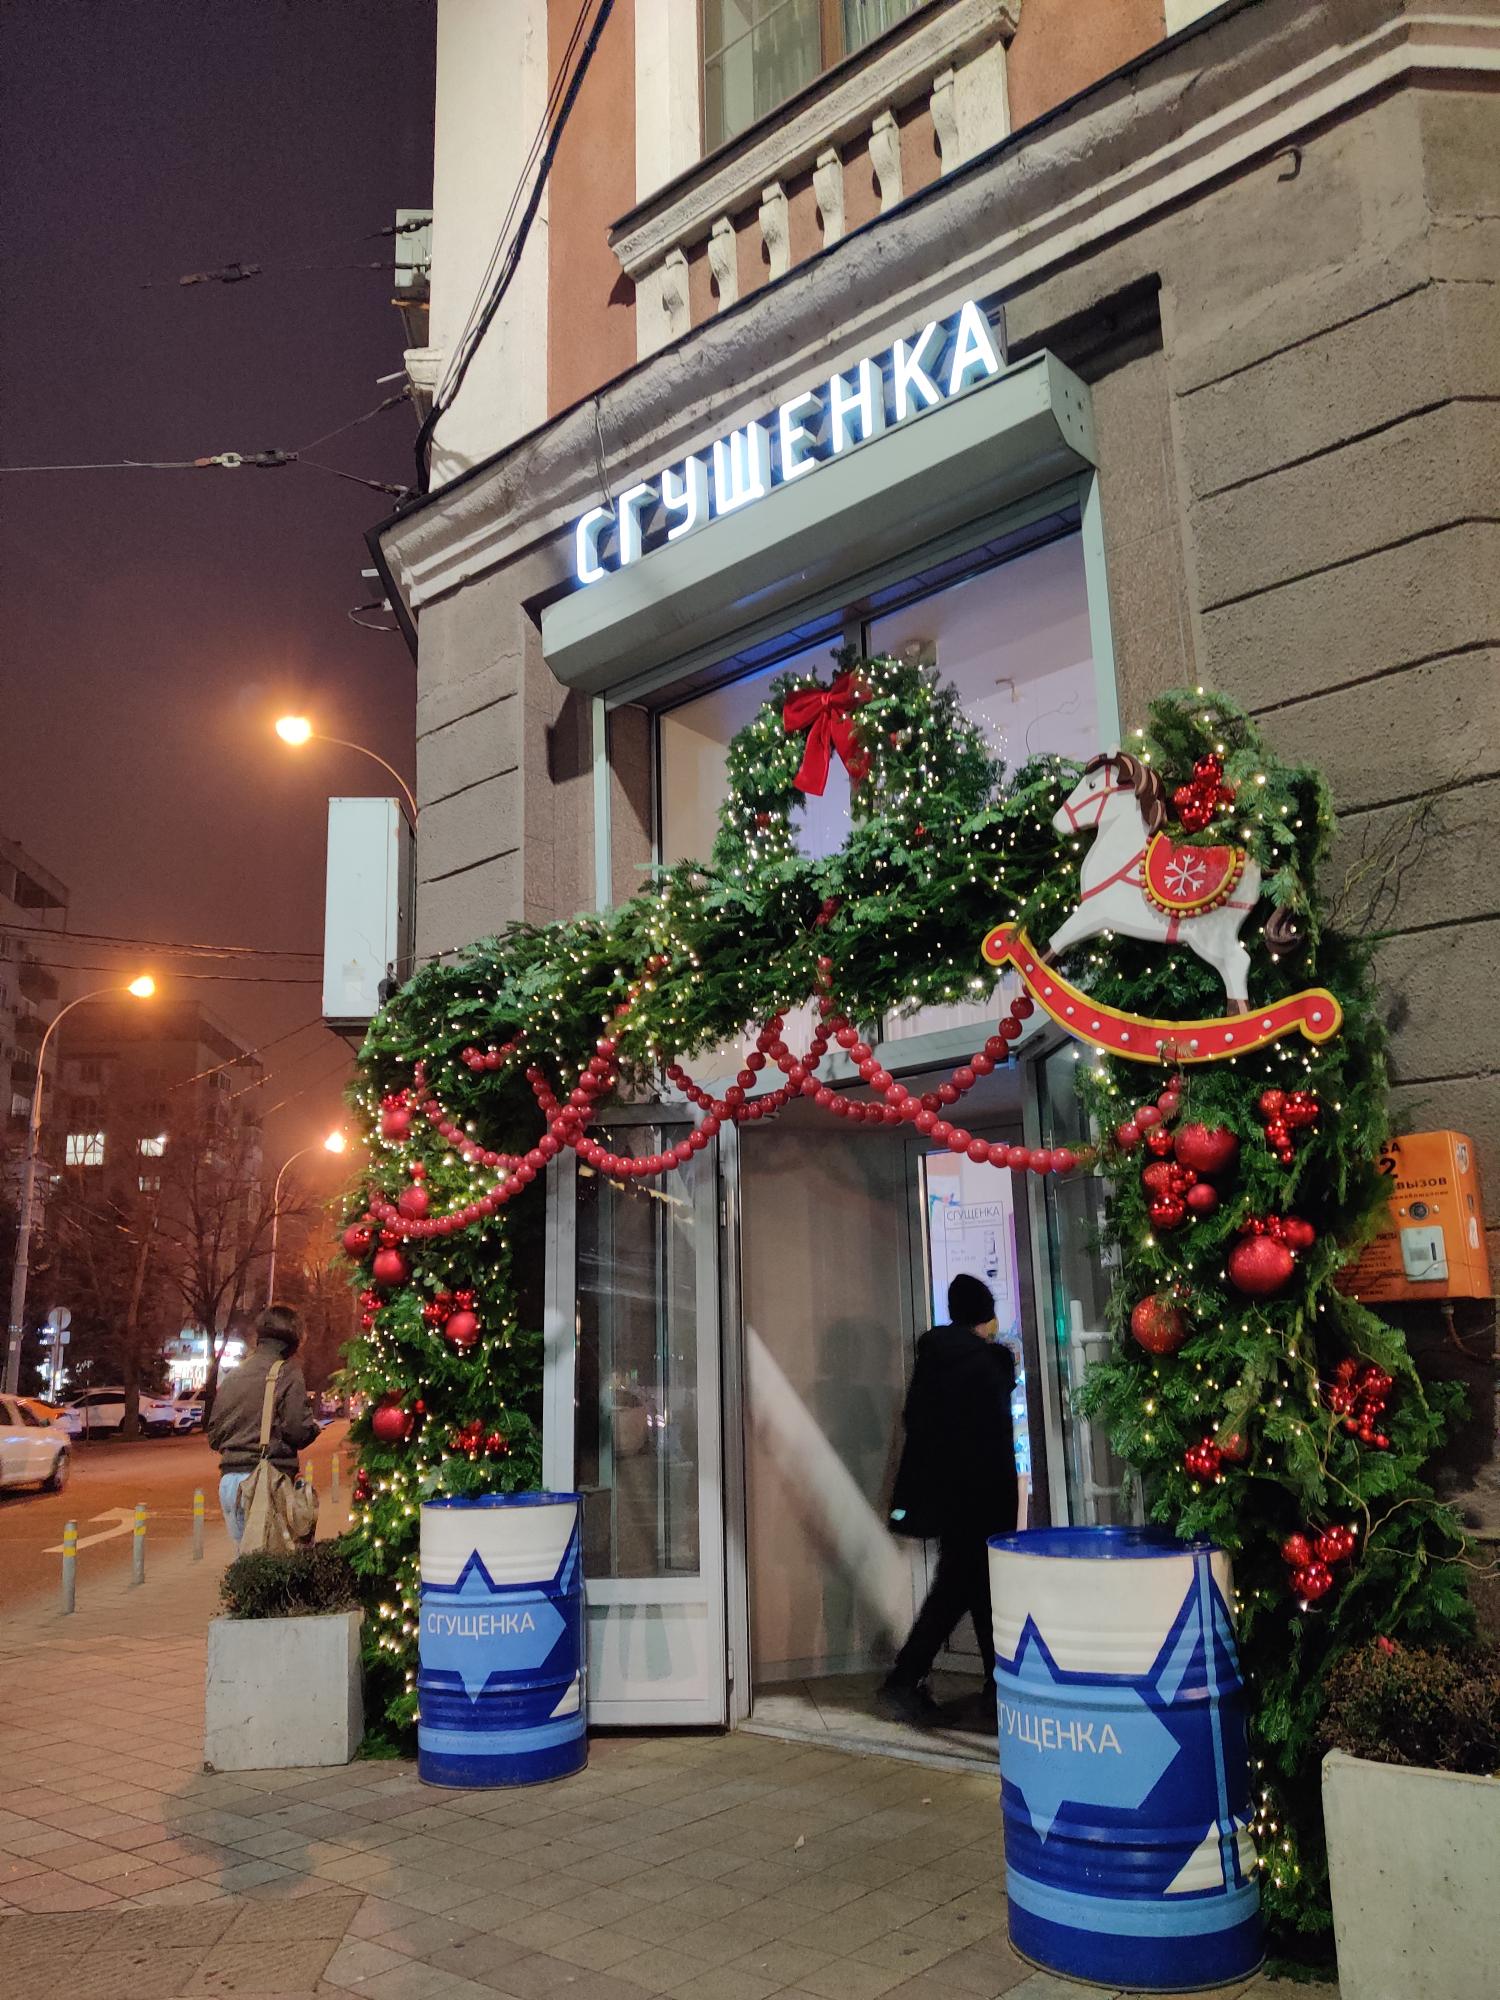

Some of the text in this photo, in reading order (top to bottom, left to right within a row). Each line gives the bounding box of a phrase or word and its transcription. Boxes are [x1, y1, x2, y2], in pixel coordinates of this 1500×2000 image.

[576, 300, 1000, 584] СГУЩЕНКА
[1396, 1177, 1447, 1190] ВЫЗОВ
[946, 1206, 1000, 1221] СГУЩЕНКА
[427, 1612, 535, 1640] СГУЩЕНКА
